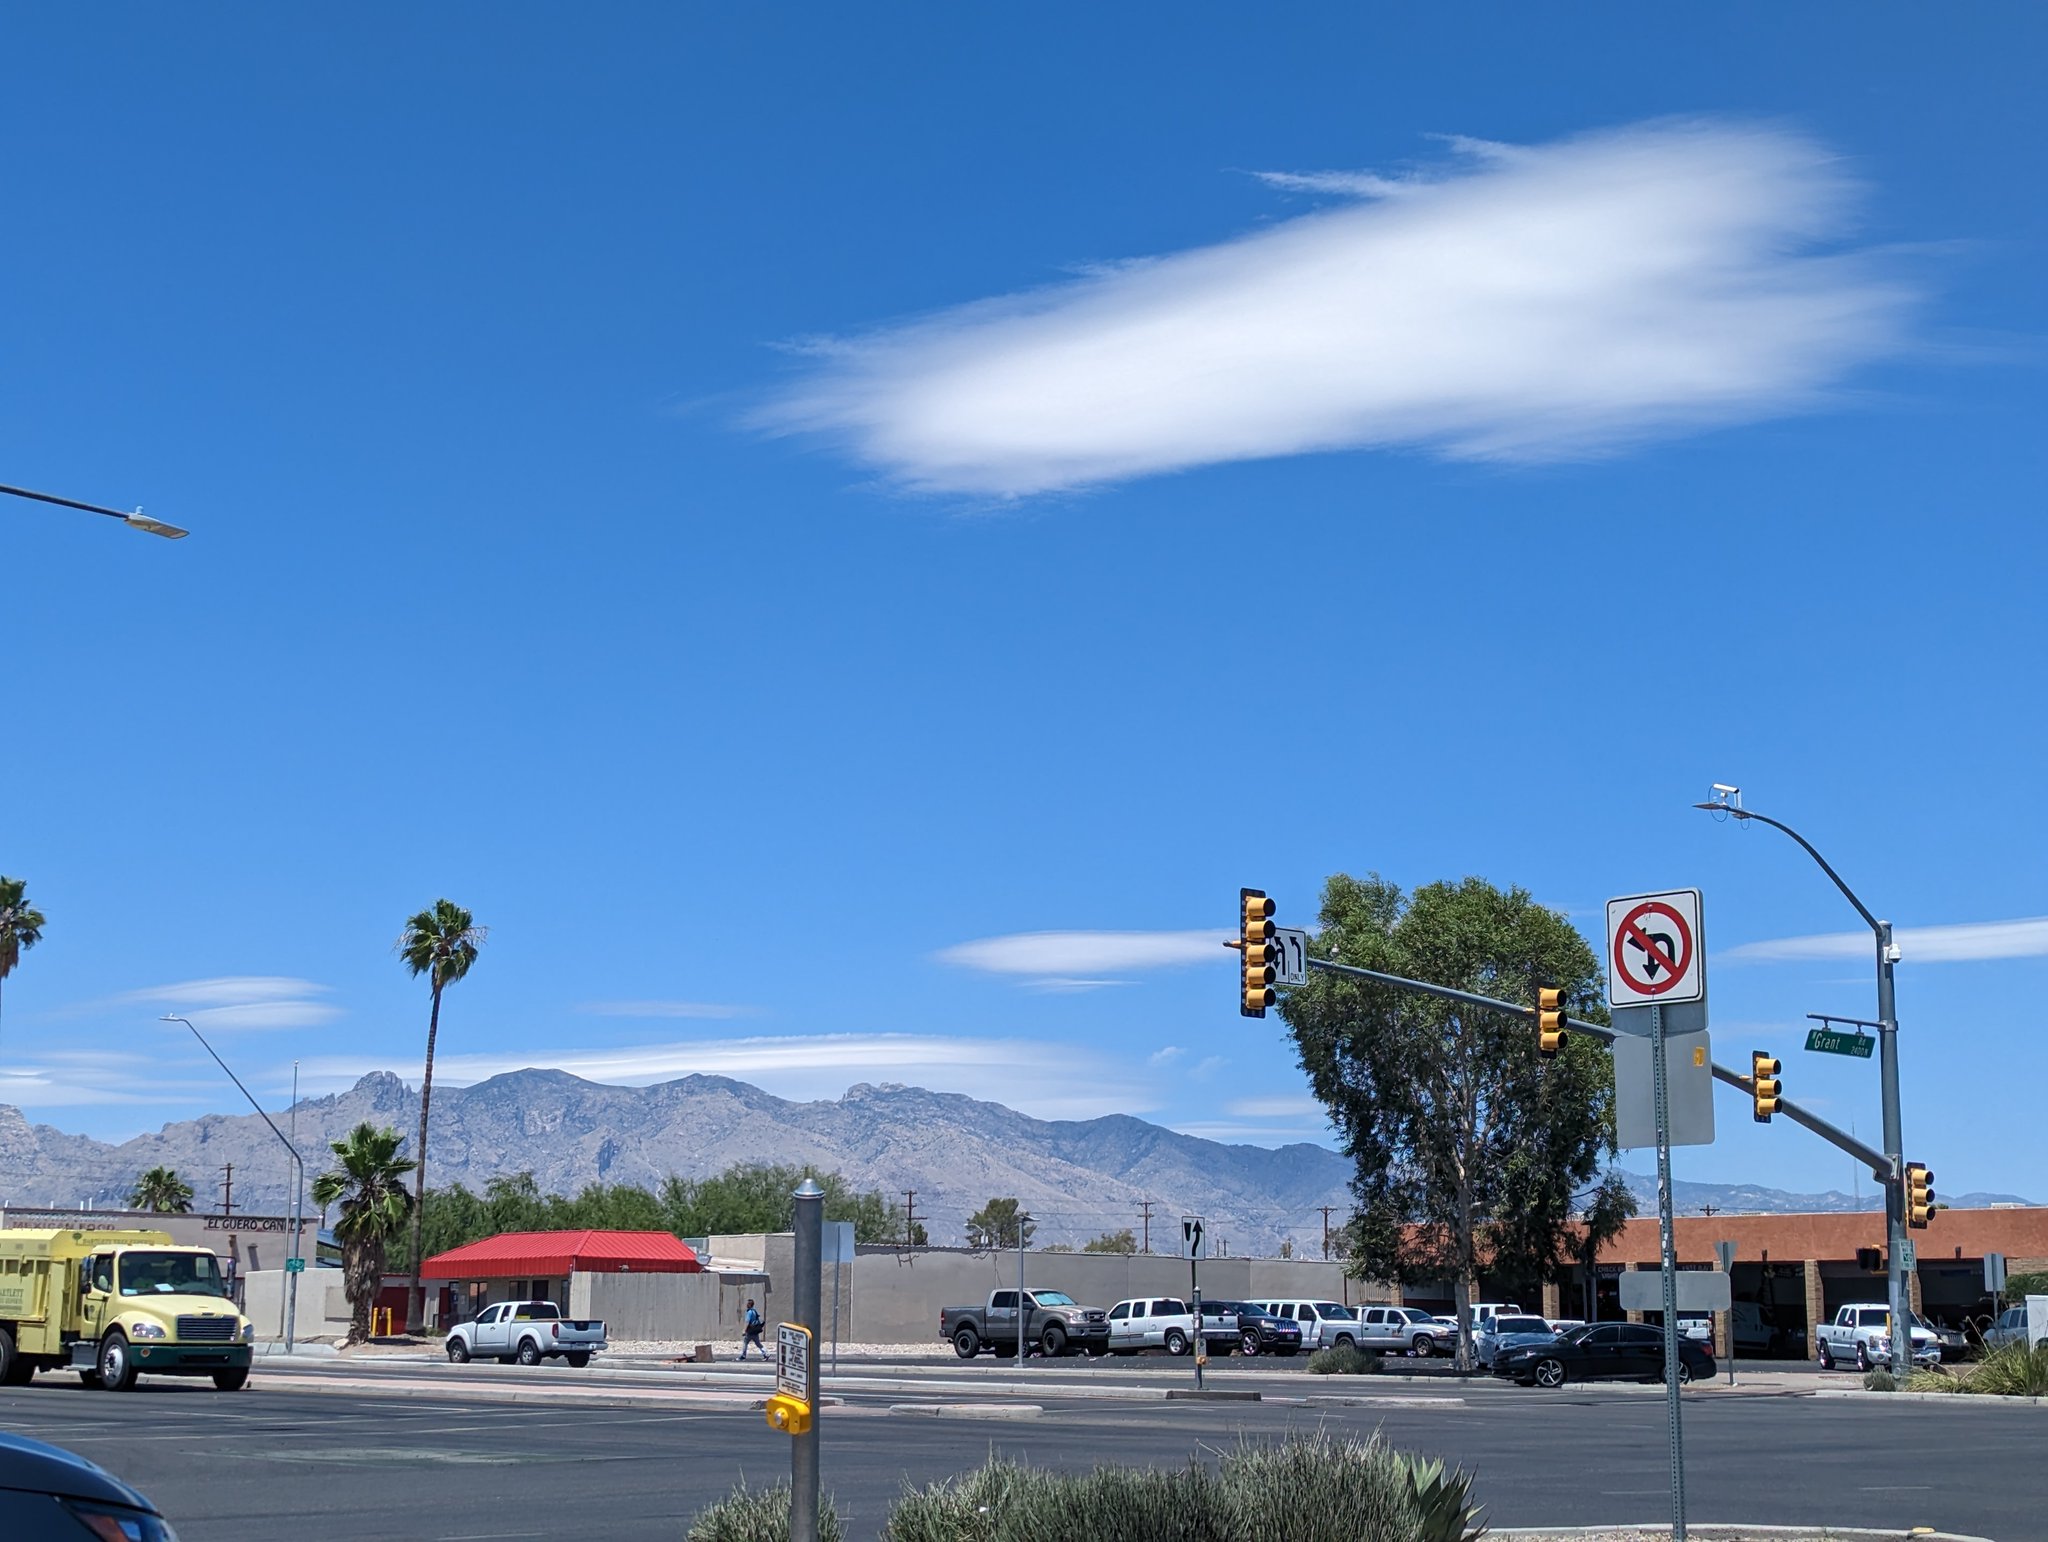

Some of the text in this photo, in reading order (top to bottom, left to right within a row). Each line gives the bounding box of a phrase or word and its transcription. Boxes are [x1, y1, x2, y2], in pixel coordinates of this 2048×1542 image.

[1290, 972, 1305, 982] ONLY
[1814, 1032, 1841, 1050] Grant
[12, 1221, 116, 1231] MEXICAN FOOD
[208, 1218, 220, 1229] EL
[222, 1219, 258, 1230] GUERO
